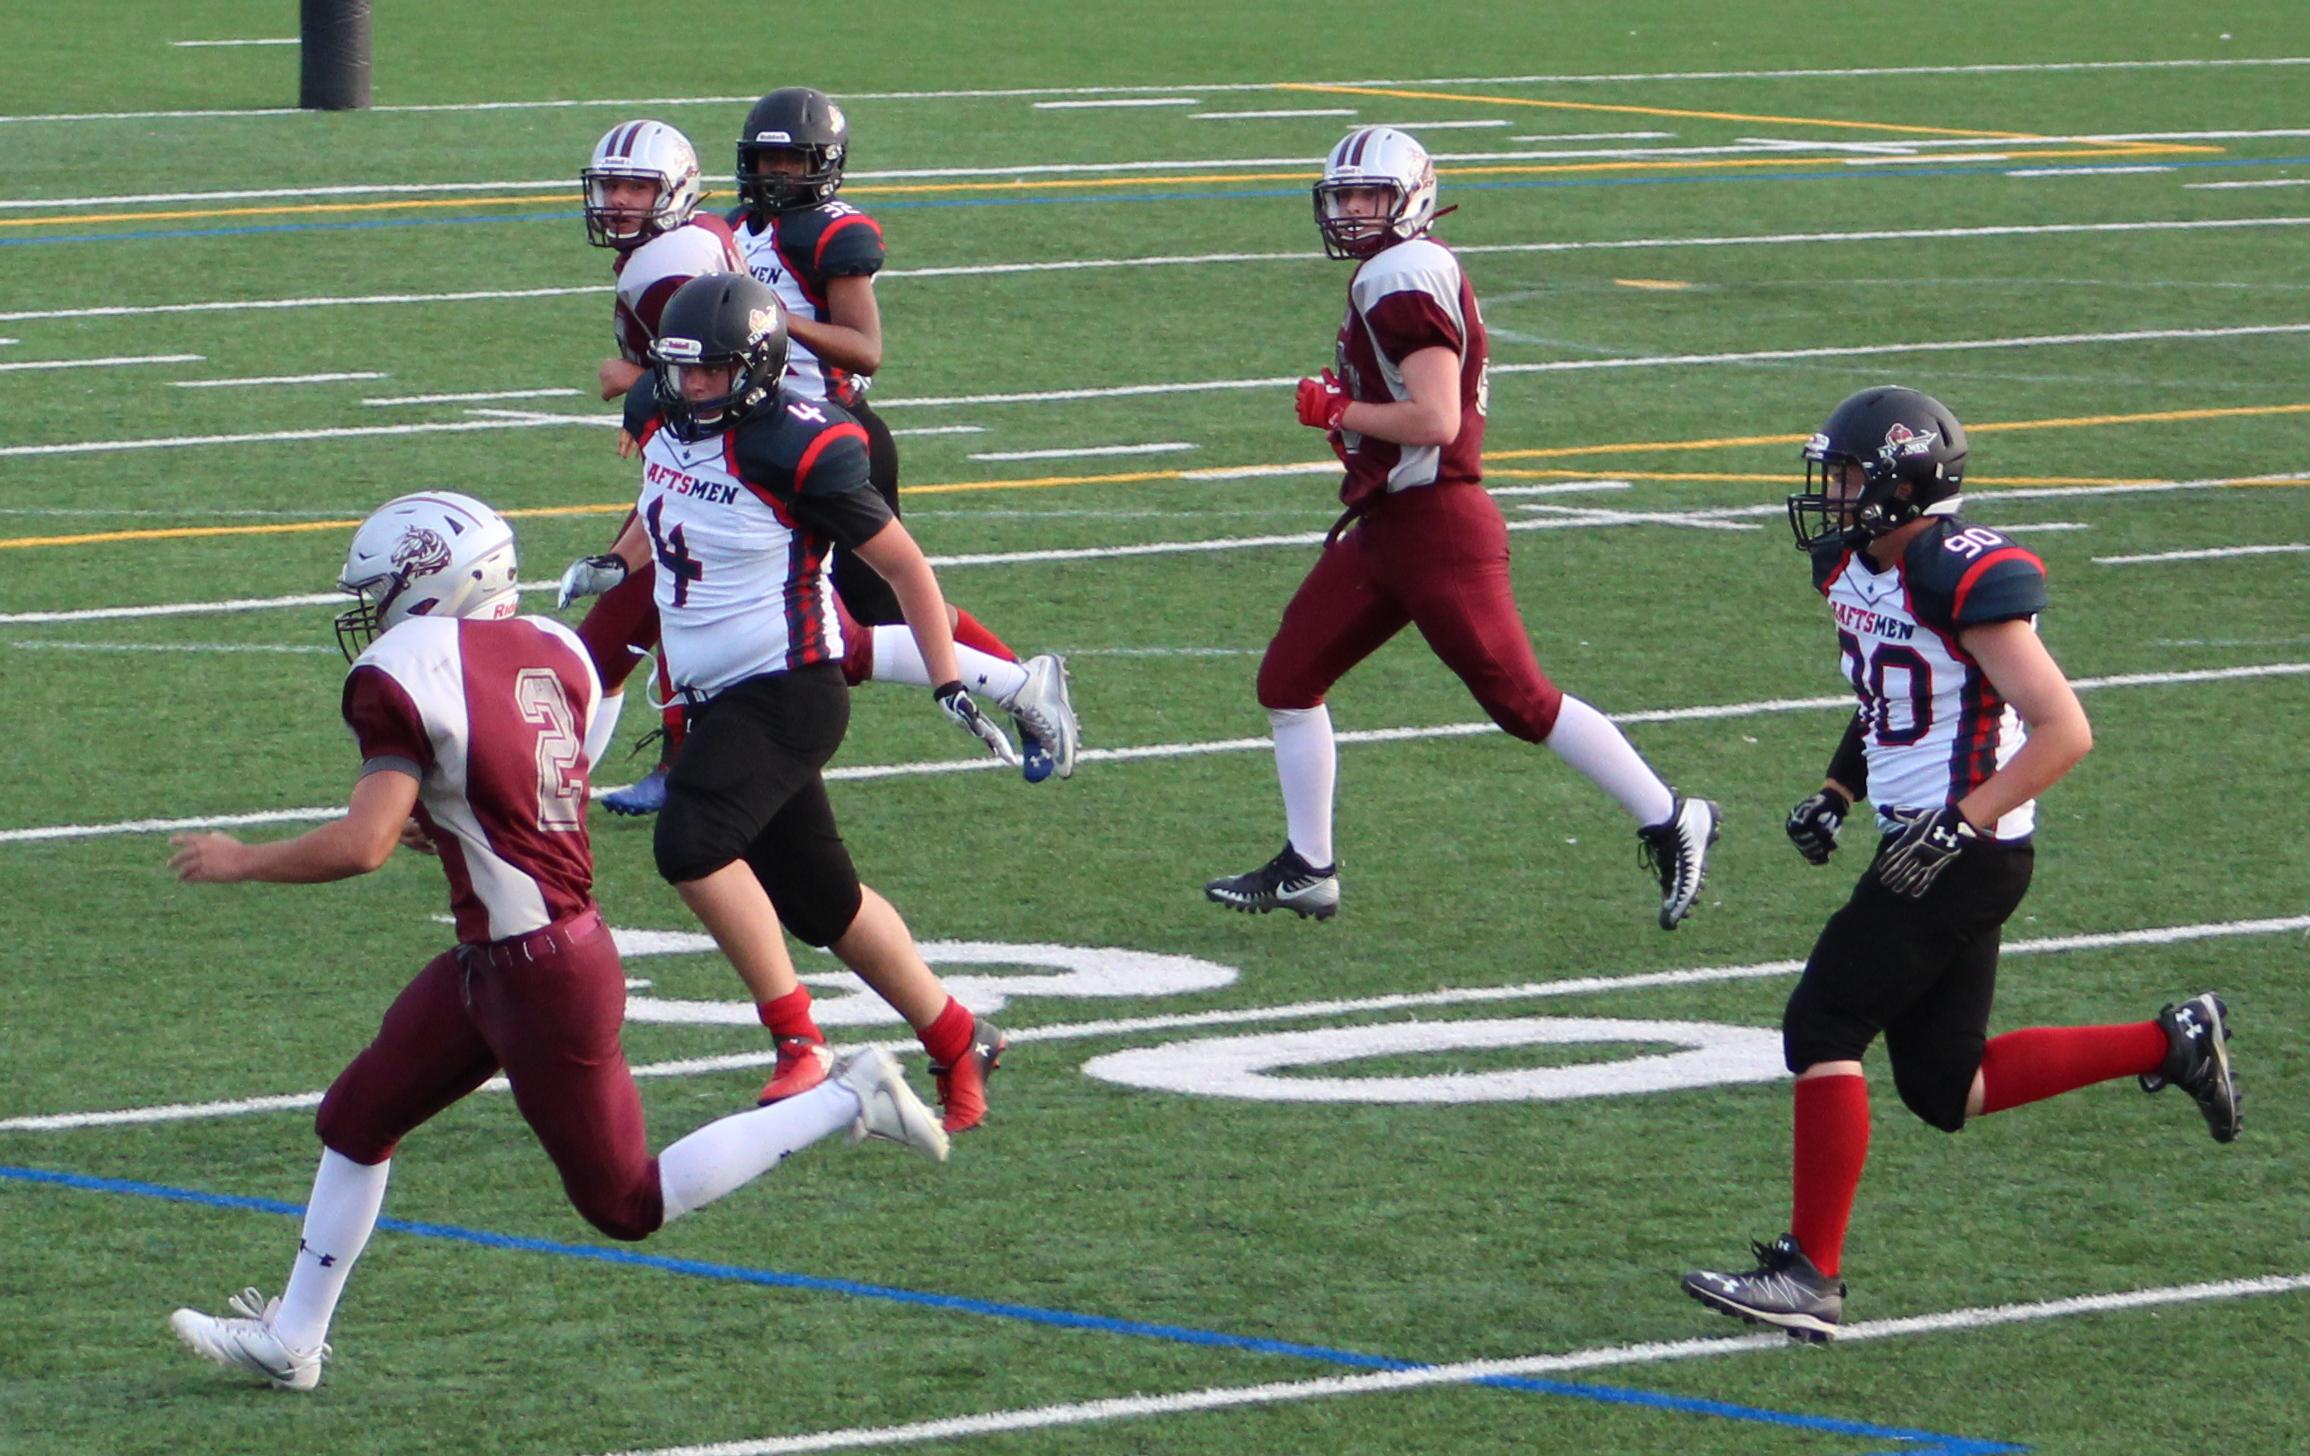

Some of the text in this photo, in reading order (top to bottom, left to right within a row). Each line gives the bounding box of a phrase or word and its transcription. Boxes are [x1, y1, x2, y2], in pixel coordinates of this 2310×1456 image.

[787, 402, 828, 424] 4
[647, 462, 740, 505] AFTSMEN
[646, 494, 703, 609] 4
[1944, 527, 2003, 560] 90
[514, 667, 581, 833] 2
